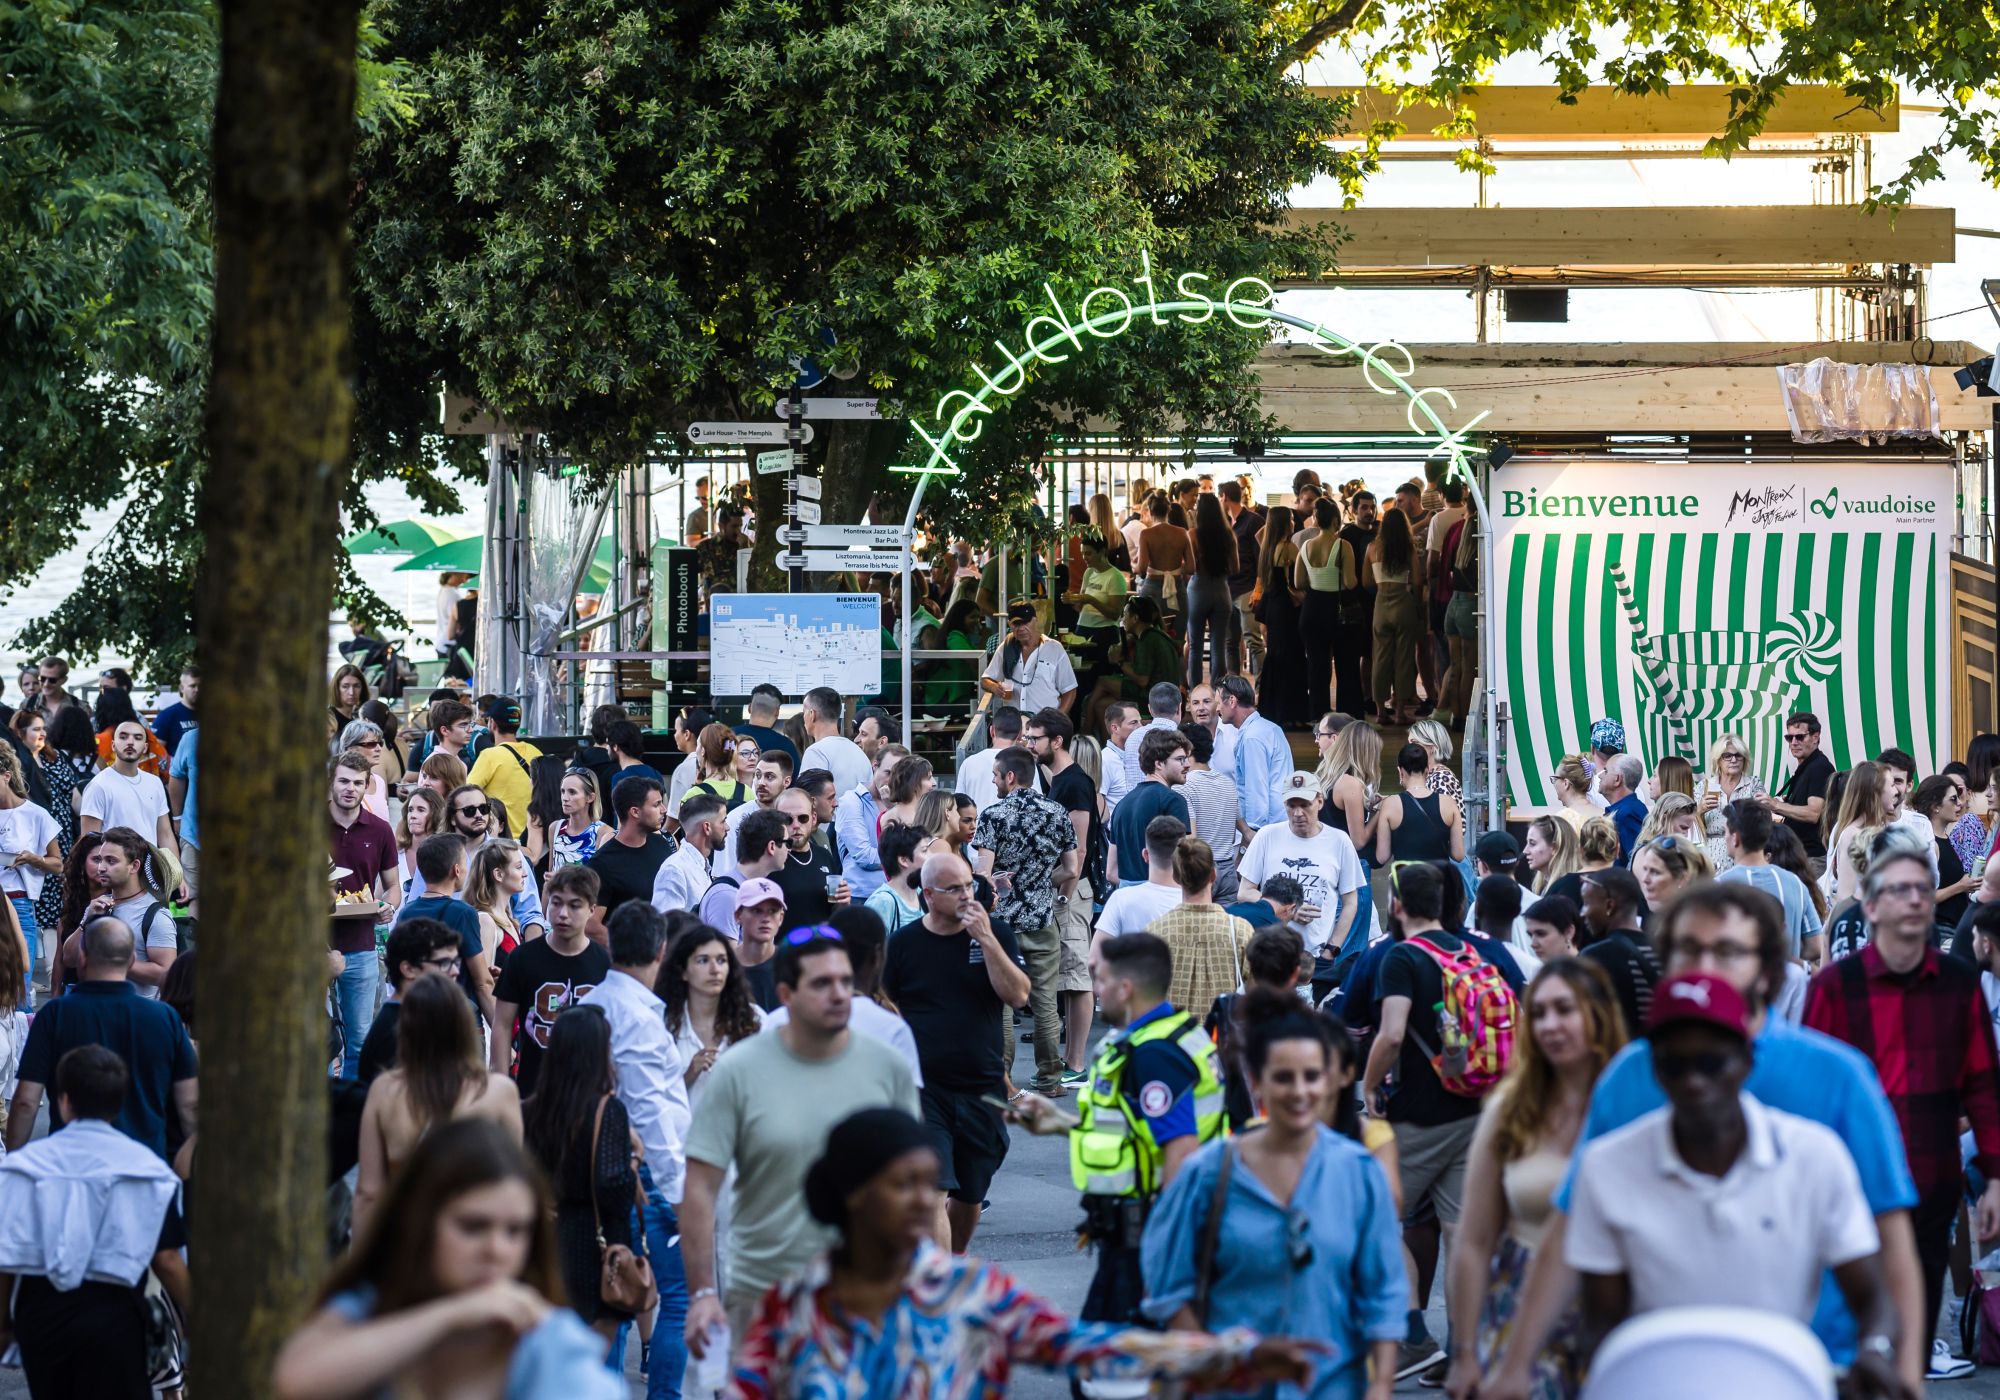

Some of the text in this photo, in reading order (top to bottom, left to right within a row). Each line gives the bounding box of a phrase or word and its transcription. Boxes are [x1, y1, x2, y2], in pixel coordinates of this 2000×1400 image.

[846, 401, 864, 409] Super
[1501, 487, 1699, 518] Bienvenue
[1842, 494, 1936, 514] vaudoise
[873, 553, 899, 561] Ipanema
[676, 563, 689, 634] Photobooth
